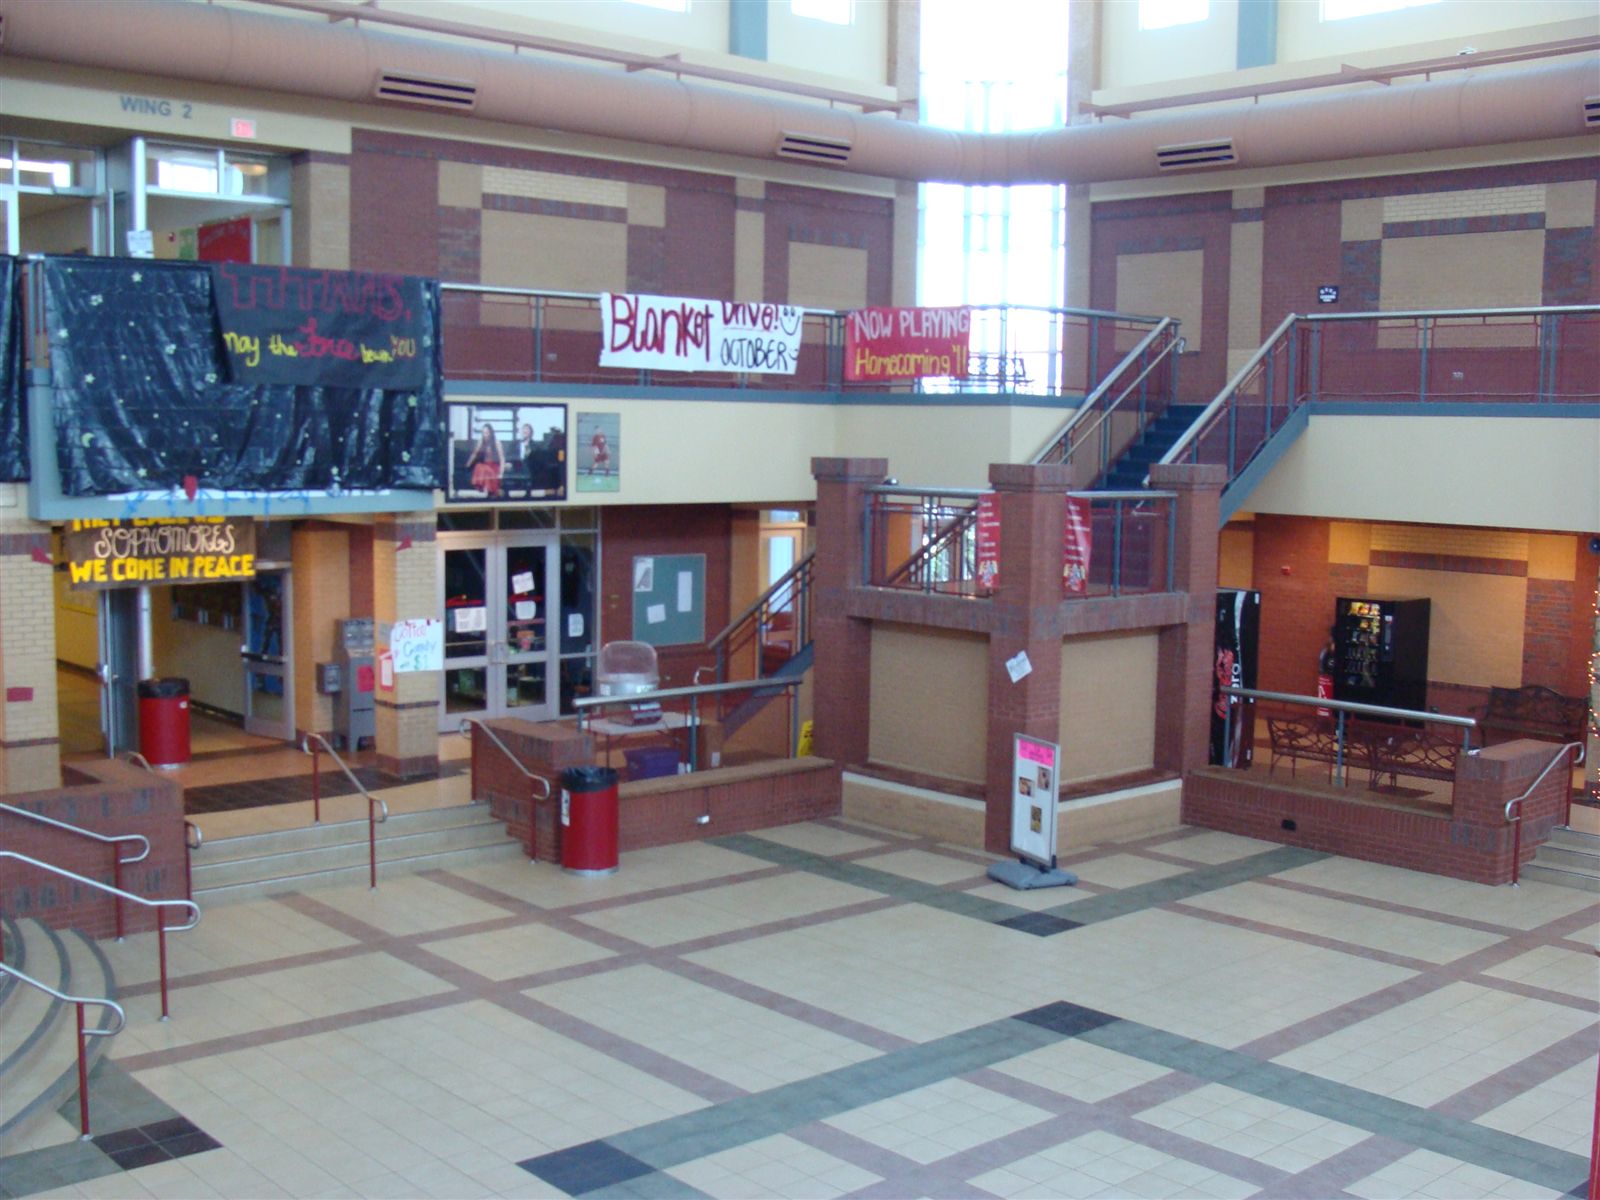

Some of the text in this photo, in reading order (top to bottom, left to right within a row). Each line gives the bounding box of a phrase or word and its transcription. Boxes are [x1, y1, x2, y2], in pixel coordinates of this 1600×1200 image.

[120, 95, 192, 119] WING 2
[610, 293, 714, 363] Blanket
[853, 308, 970, 343] NOW PLAYING
[720, 337, 789, 371] OCTOBER
[854, 347, 950, 376] Homecoming
[94, 524, 236, 559] SOPHOMORES
[70, 554, 256, 583] WE COME IN PEACE
